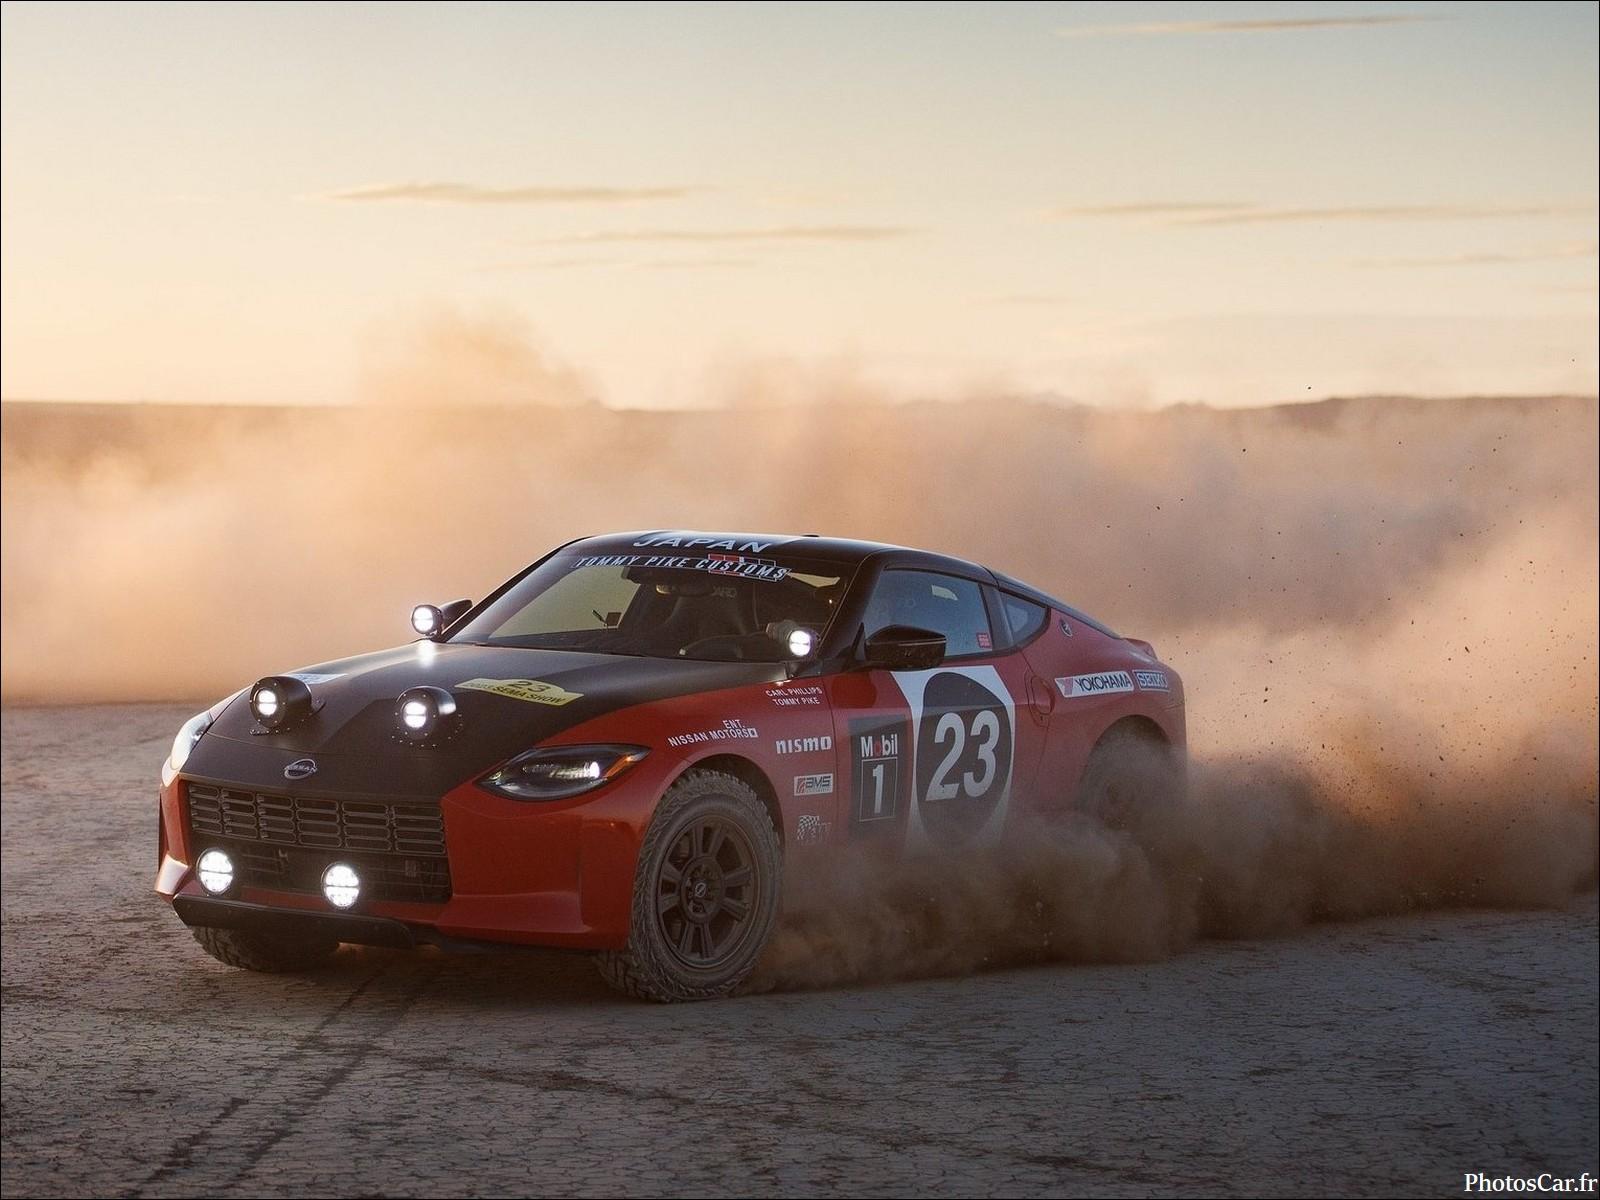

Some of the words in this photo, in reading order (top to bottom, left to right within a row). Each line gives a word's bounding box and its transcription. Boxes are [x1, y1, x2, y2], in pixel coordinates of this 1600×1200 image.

[633, 537, 772, 553] JAPAN
[576, 556, 640, 567] TOMMY
[644, 556, 690, 568] PIKE
[695, 559, 787, 579] CUSTOMS
[506, 680, 551, 693] 23
[765, 689, 788, 697] CARL
[787, 686, 823, 696] PHILLIPS
[1075, 674, 1131, 692] YOKOHAMA
[772, 698, 800, 706] TOMMY
[801, 696, 820, 704] PIKE
[722, 719, 746, 729] ENT.
[667, 732, 709, 747] NISSAN
[708, 728, 750, 740] MOTORS
[860, 733, 898, 758] Mobil
[925, 710, 1000, 801] 23
[872, 764, 884, 814] 1
